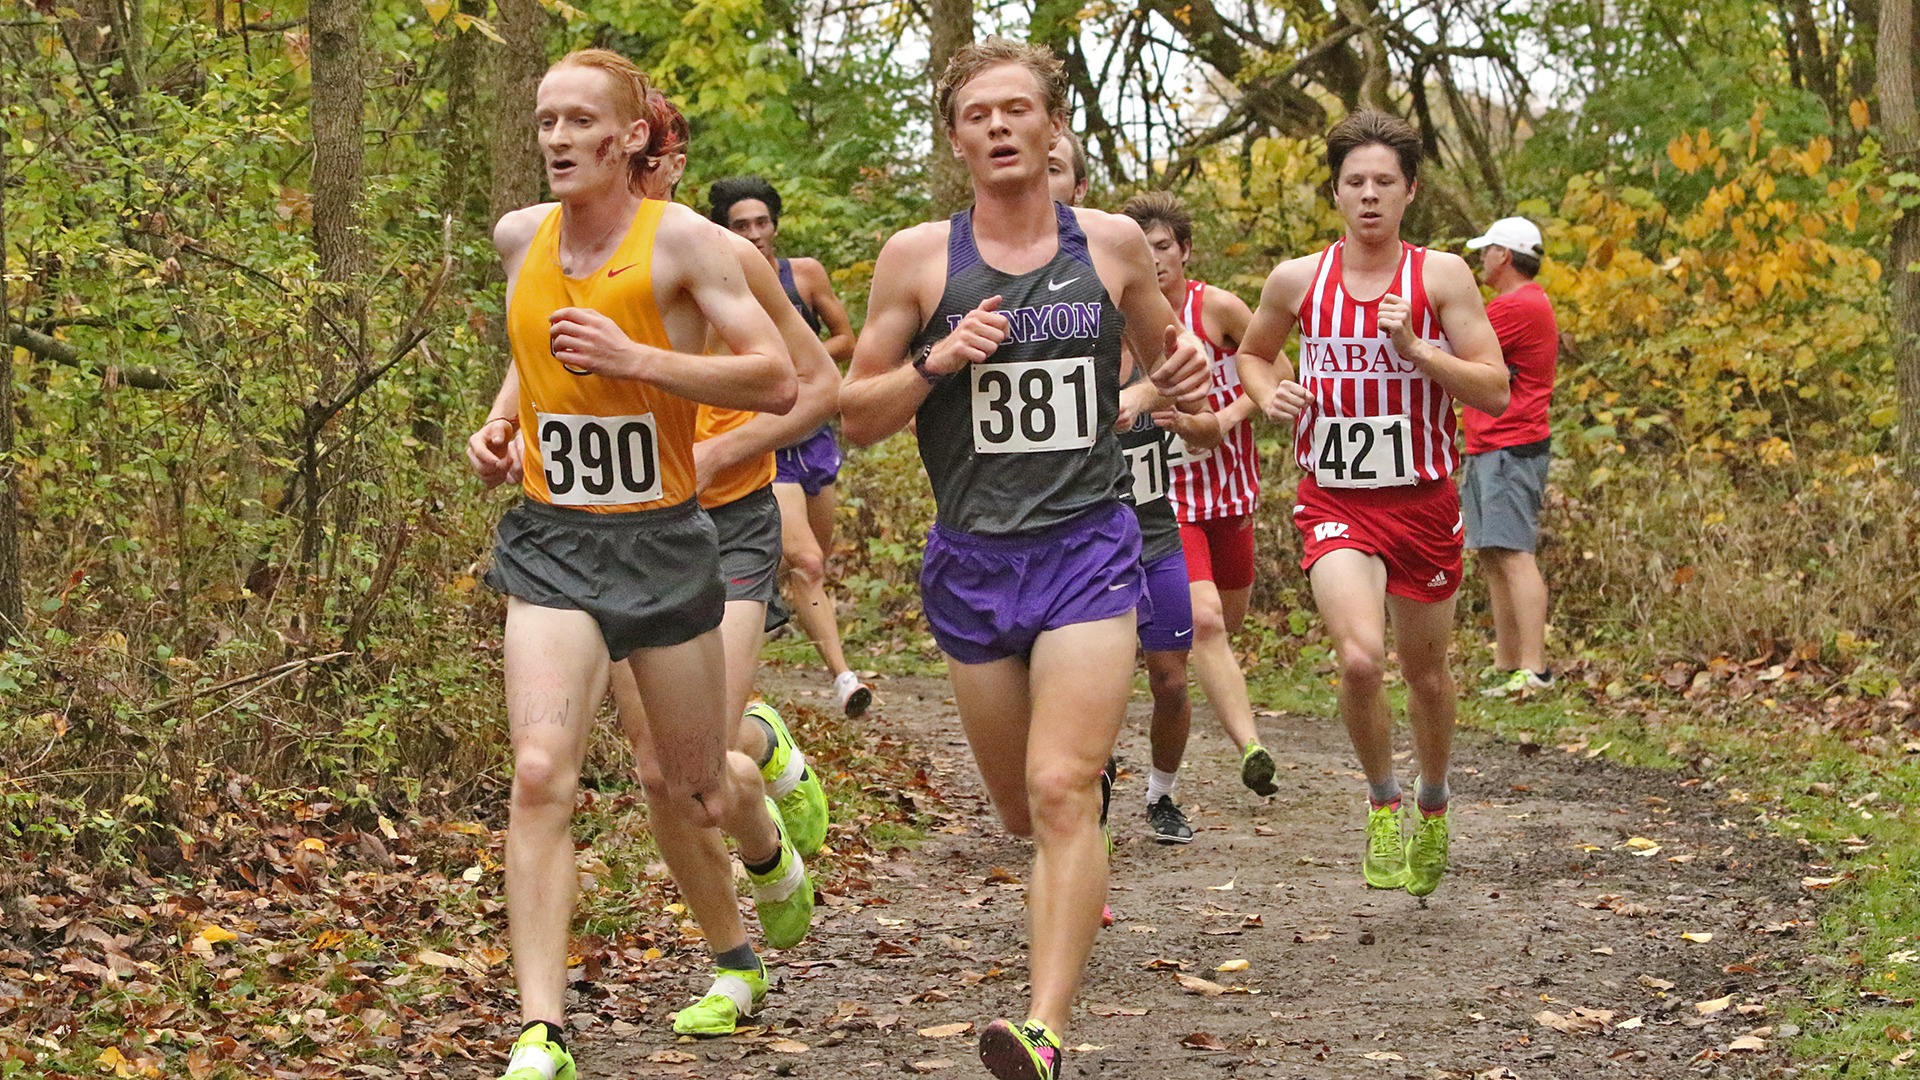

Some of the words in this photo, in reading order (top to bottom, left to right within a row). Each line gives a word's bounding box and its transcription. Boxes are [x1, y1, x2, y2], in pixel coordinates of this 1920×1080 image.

[947, 302, 1101, 346] NYON
[978, 364, 1089, 445] 381
[541, 420, 656, 496] 390
[1318, 420, 1406, 480] 421
